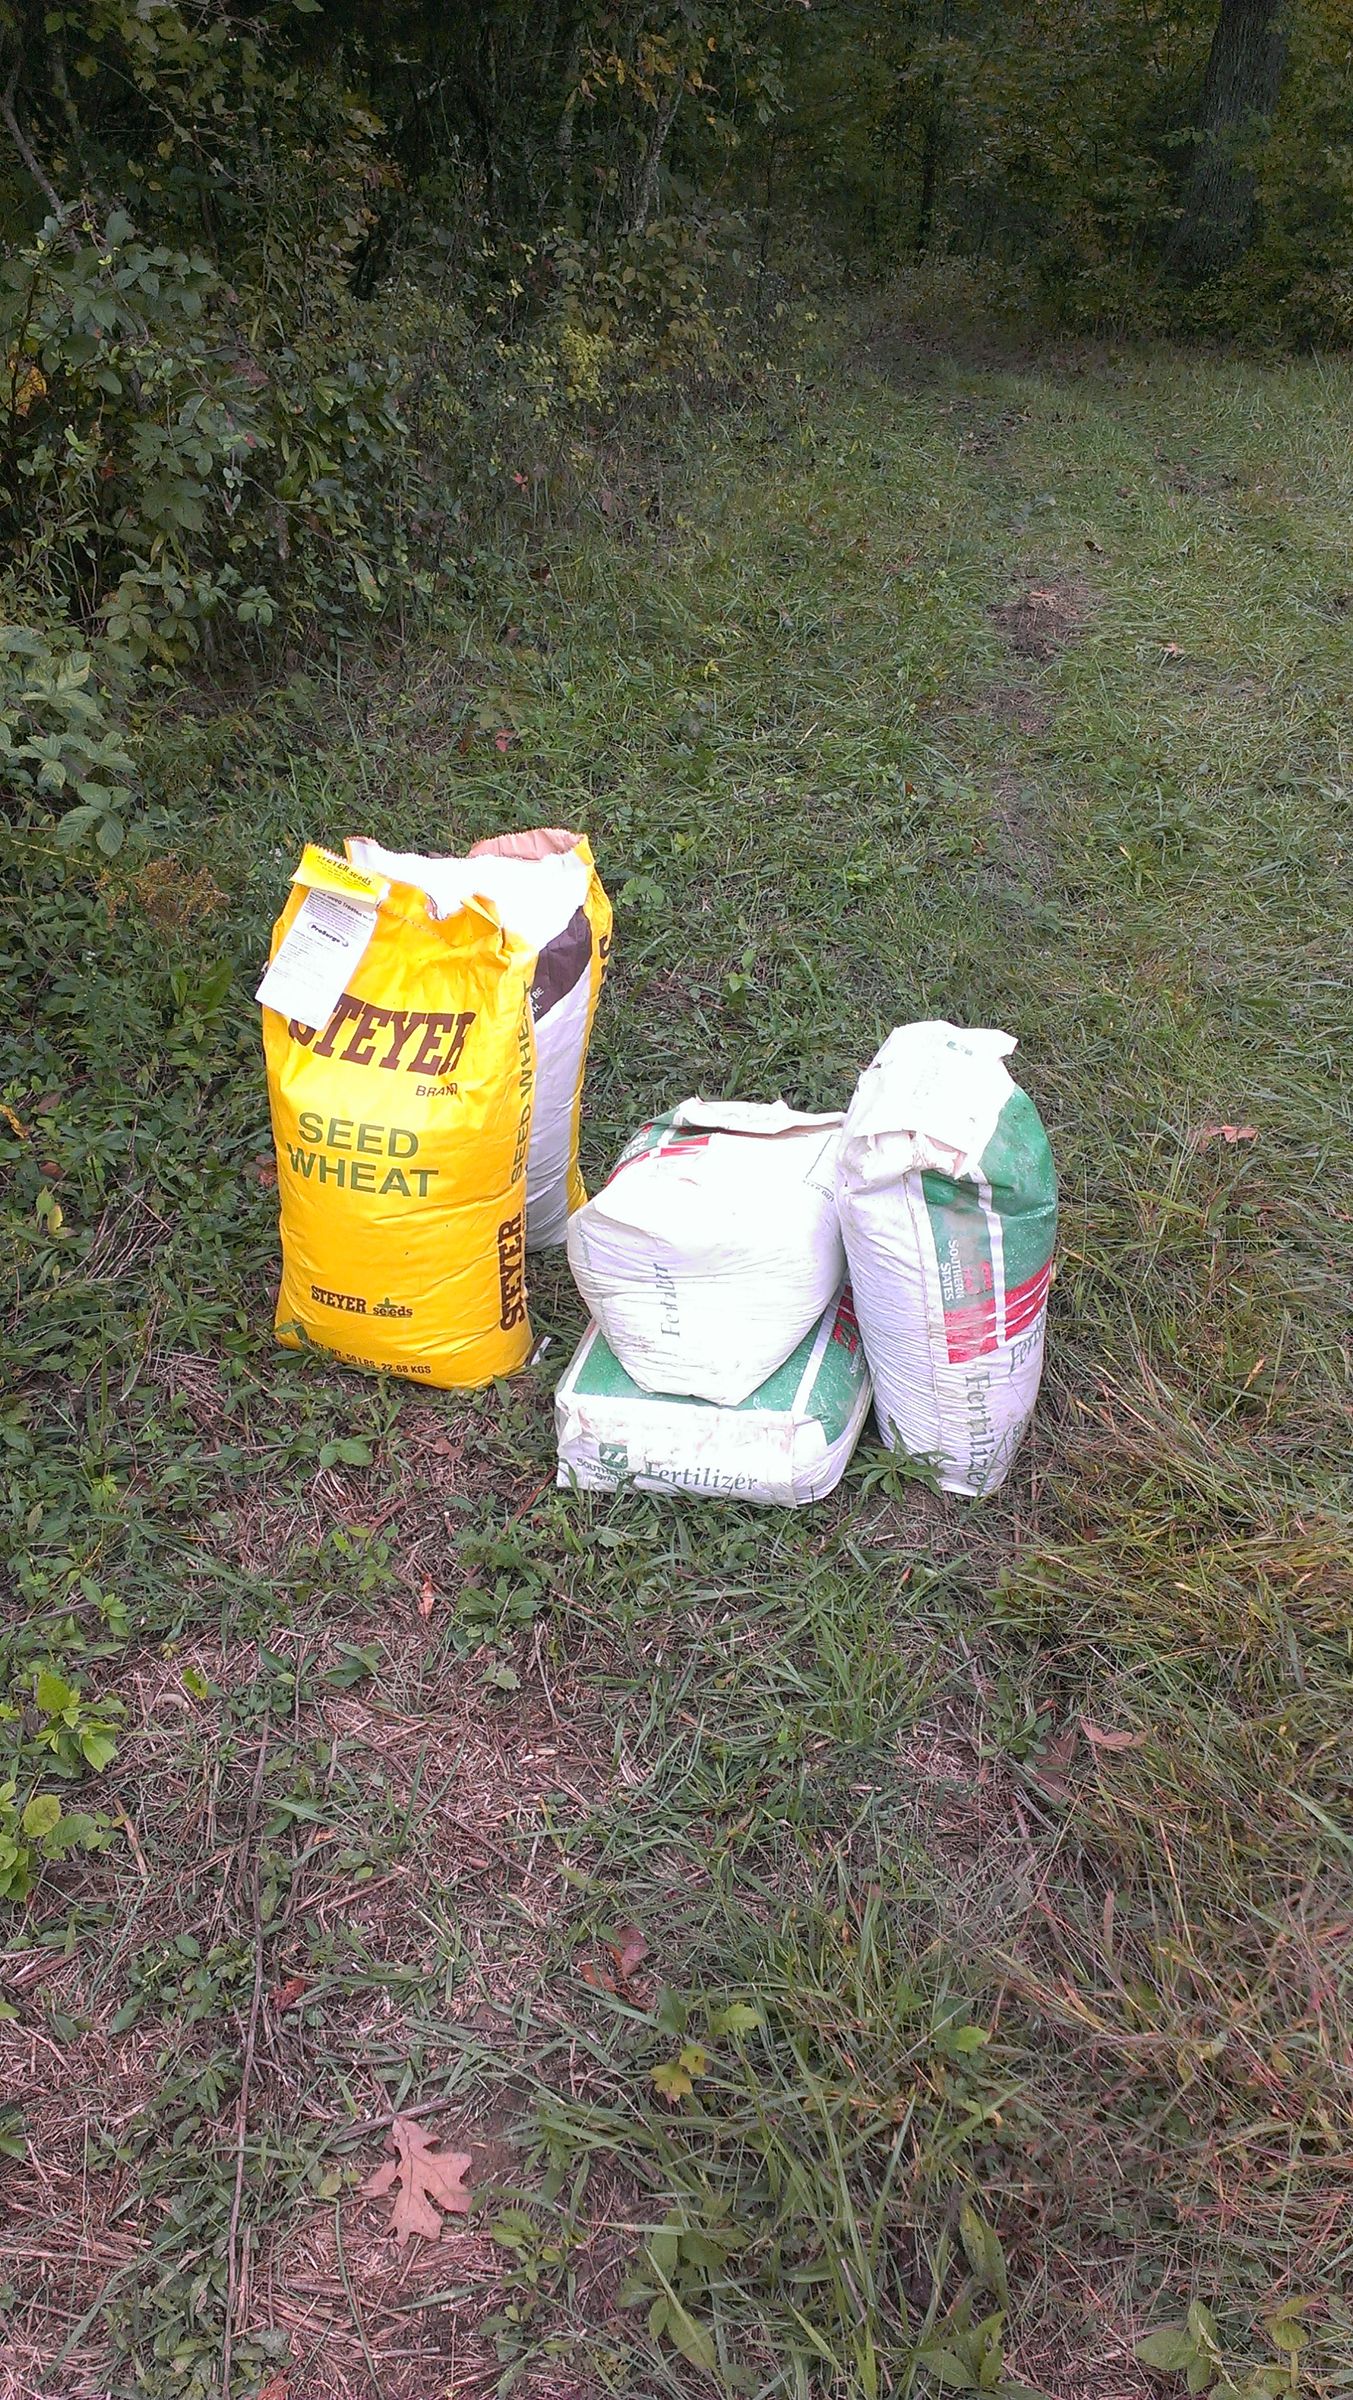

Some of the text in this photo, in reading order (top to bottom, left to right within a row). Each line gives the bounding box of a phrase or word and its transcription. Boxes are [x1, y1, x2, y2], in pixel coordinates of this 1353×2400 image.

[311, 924, 341, 943] ProSurge
[532, 986, 545, 1000] BE
[511, 980, 533, 1184] SEED WHET
[298, 1112, 419, 1159] SEED
[286, 1142, 439, 1197] WHEAT
[498, 1211, 525, 1331] STEYER
[940, 1262, 955, 1301] STATES
[948, 1239, 966, 1299] SOUTHERN
[311, 1285, 413, 1317] STEYER seeds
[381, 1362, 409, 1374] 22.68
[410, 1365, 432, 1375] KGS
[576, 1457, 632, 1479] SOUTH
[644, 1459, 759, 1490] Fertilizer
